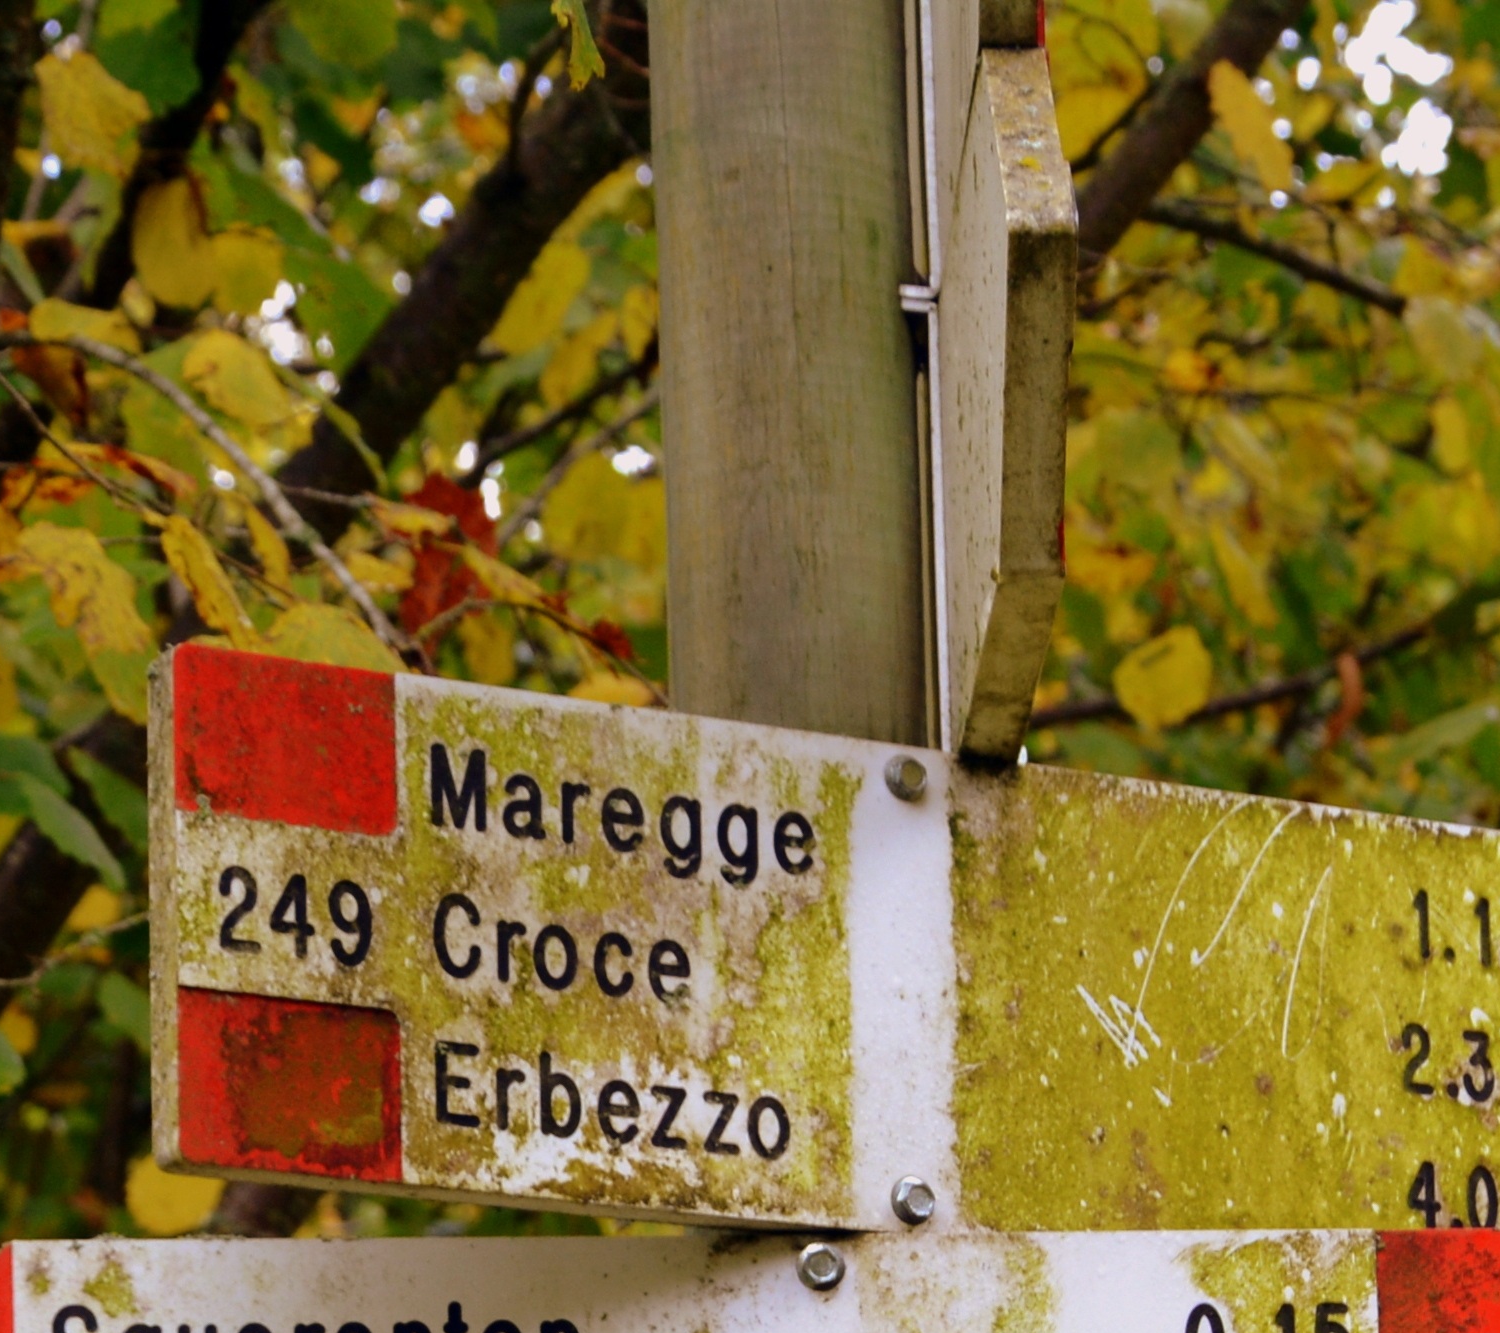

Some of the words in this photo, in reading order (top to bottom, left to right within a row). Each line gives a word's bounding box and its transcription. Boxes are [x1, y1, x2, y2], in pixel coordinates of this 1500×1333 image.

[429, 742, 816, 884] Maregge
[218, 865, 373, 966] 249
[433, 893, 691, 1002] Croce
[435, 1040, 791, 1160] Erbezzo
